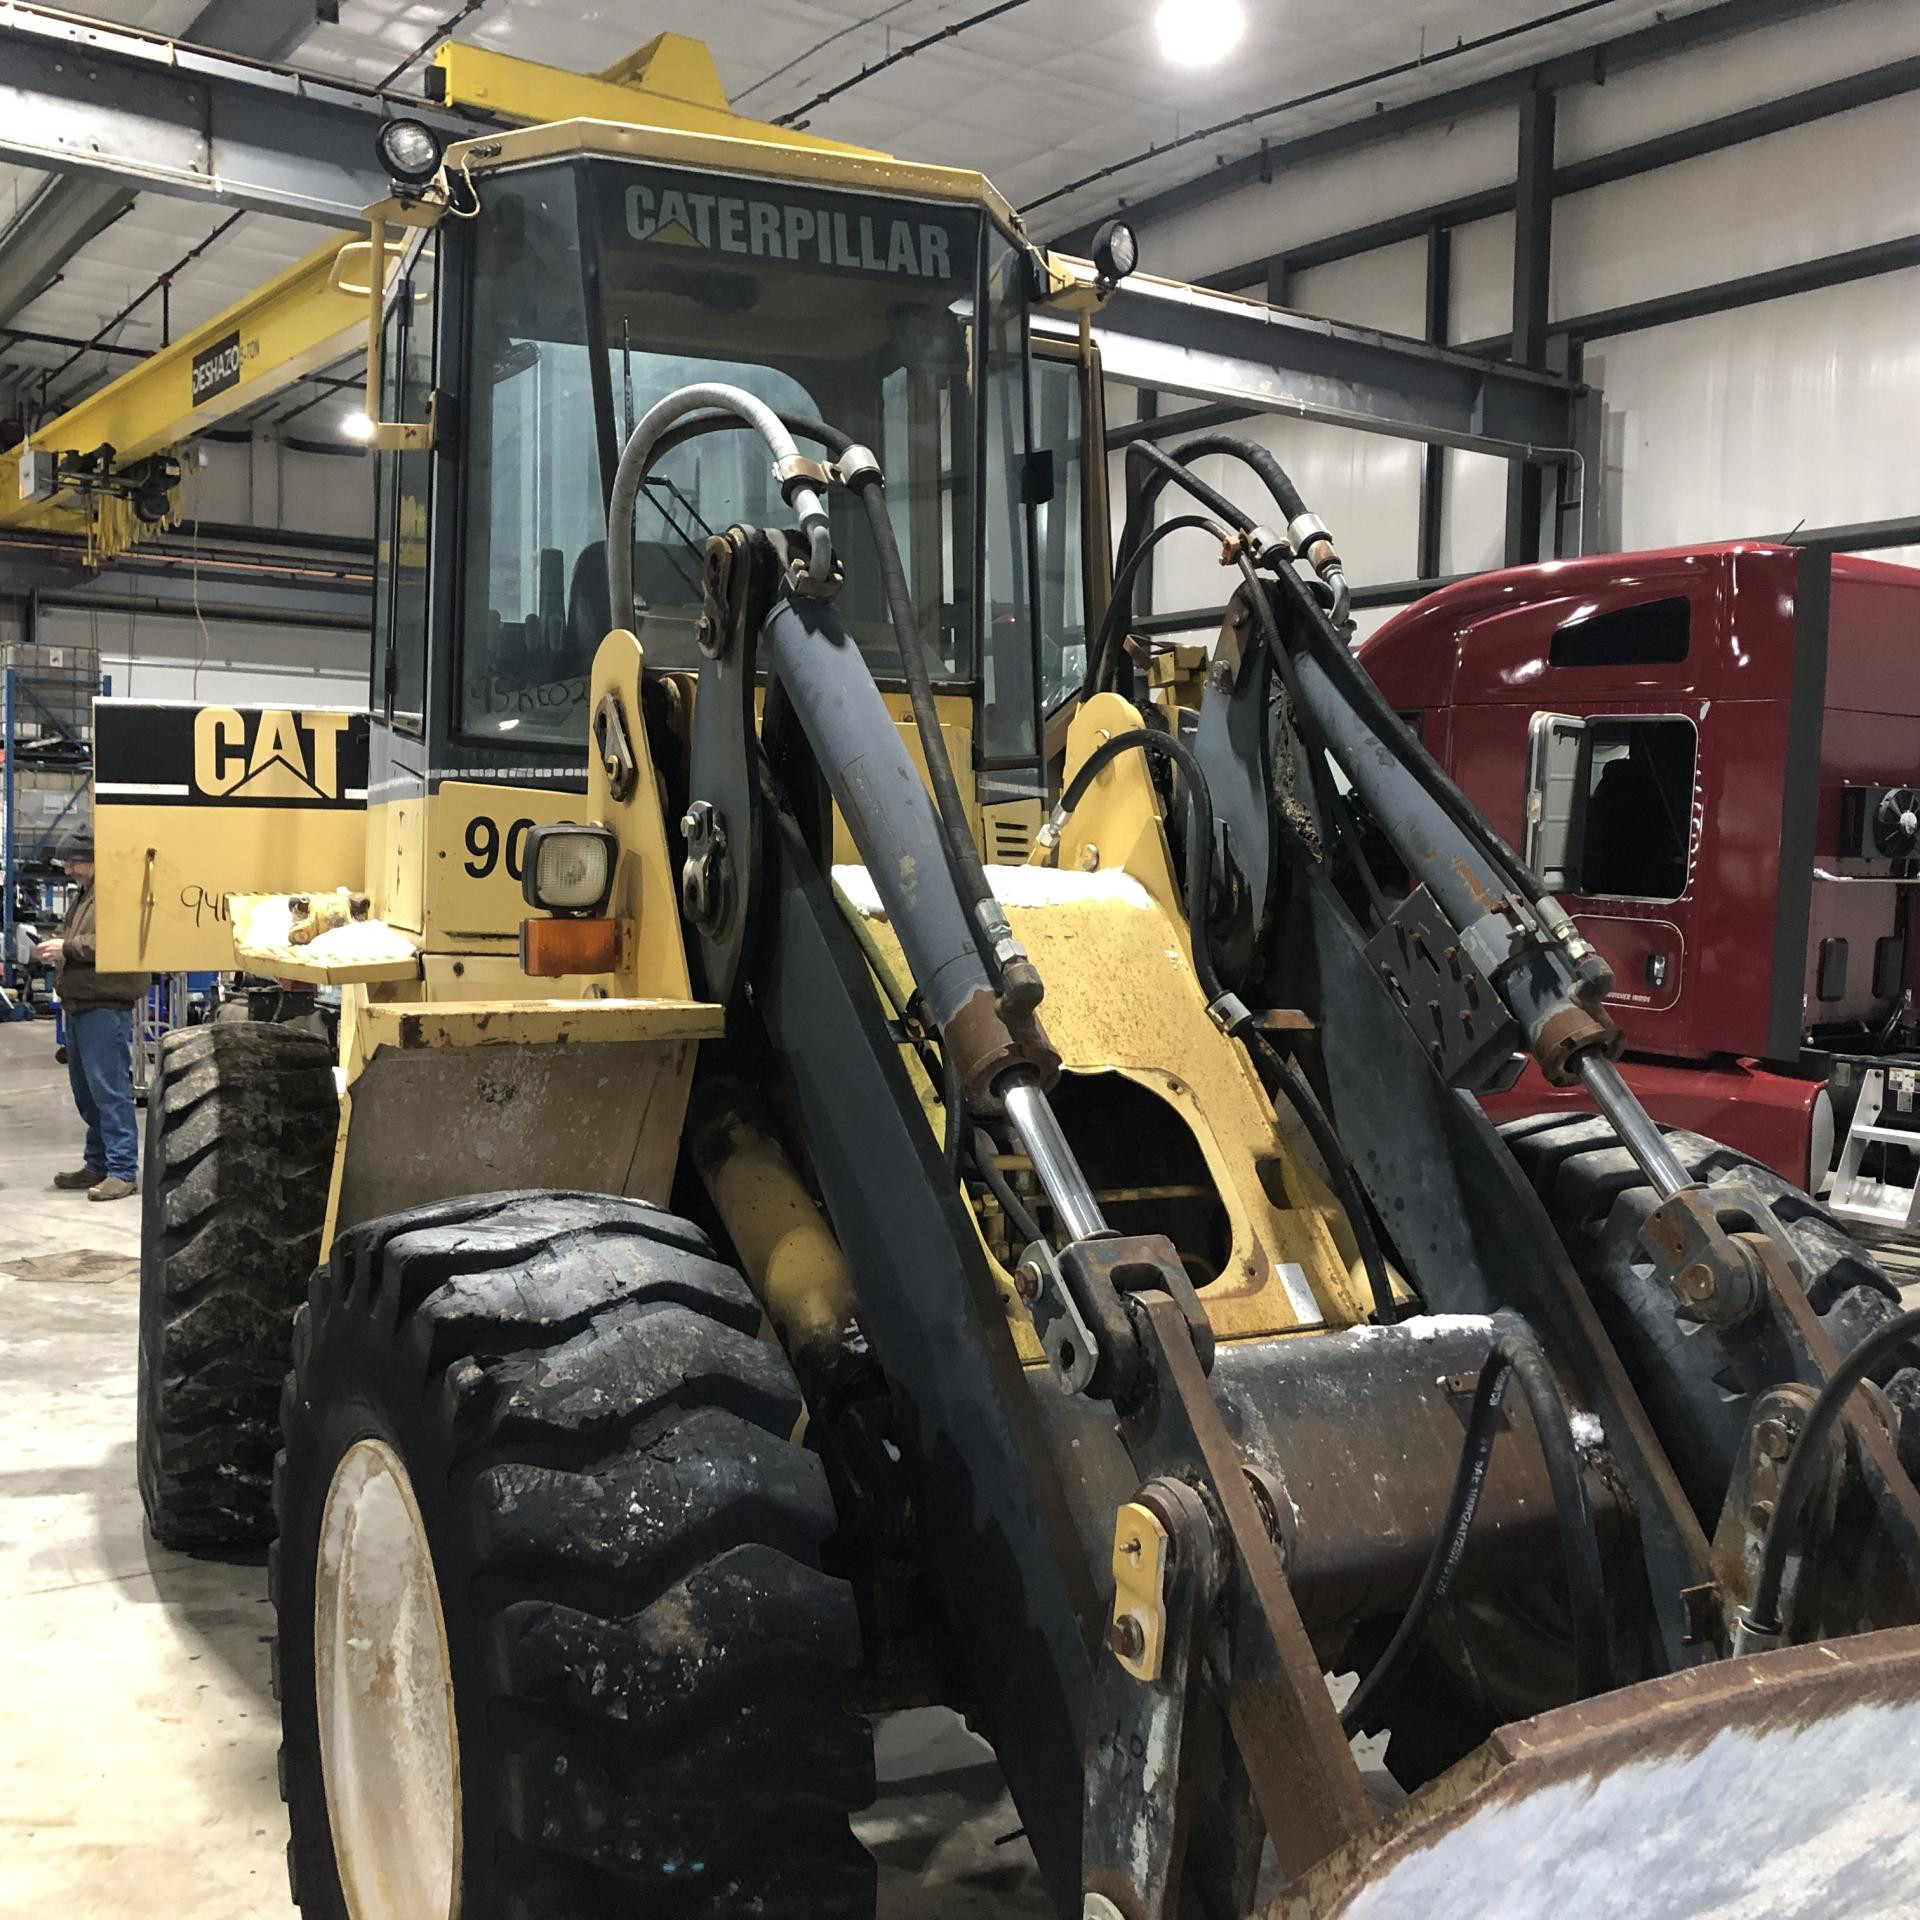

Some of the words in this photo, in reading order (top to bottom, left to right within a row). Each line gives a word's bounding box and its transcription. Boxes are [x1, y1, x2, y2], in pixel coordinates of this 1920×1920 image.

[624, 184, 952, 279] CATERPILLAR
[192, 345, 240, 395] DESHAZO
[194, 706, 349, 799] CAT
[463, 815, 575, 882] 90
